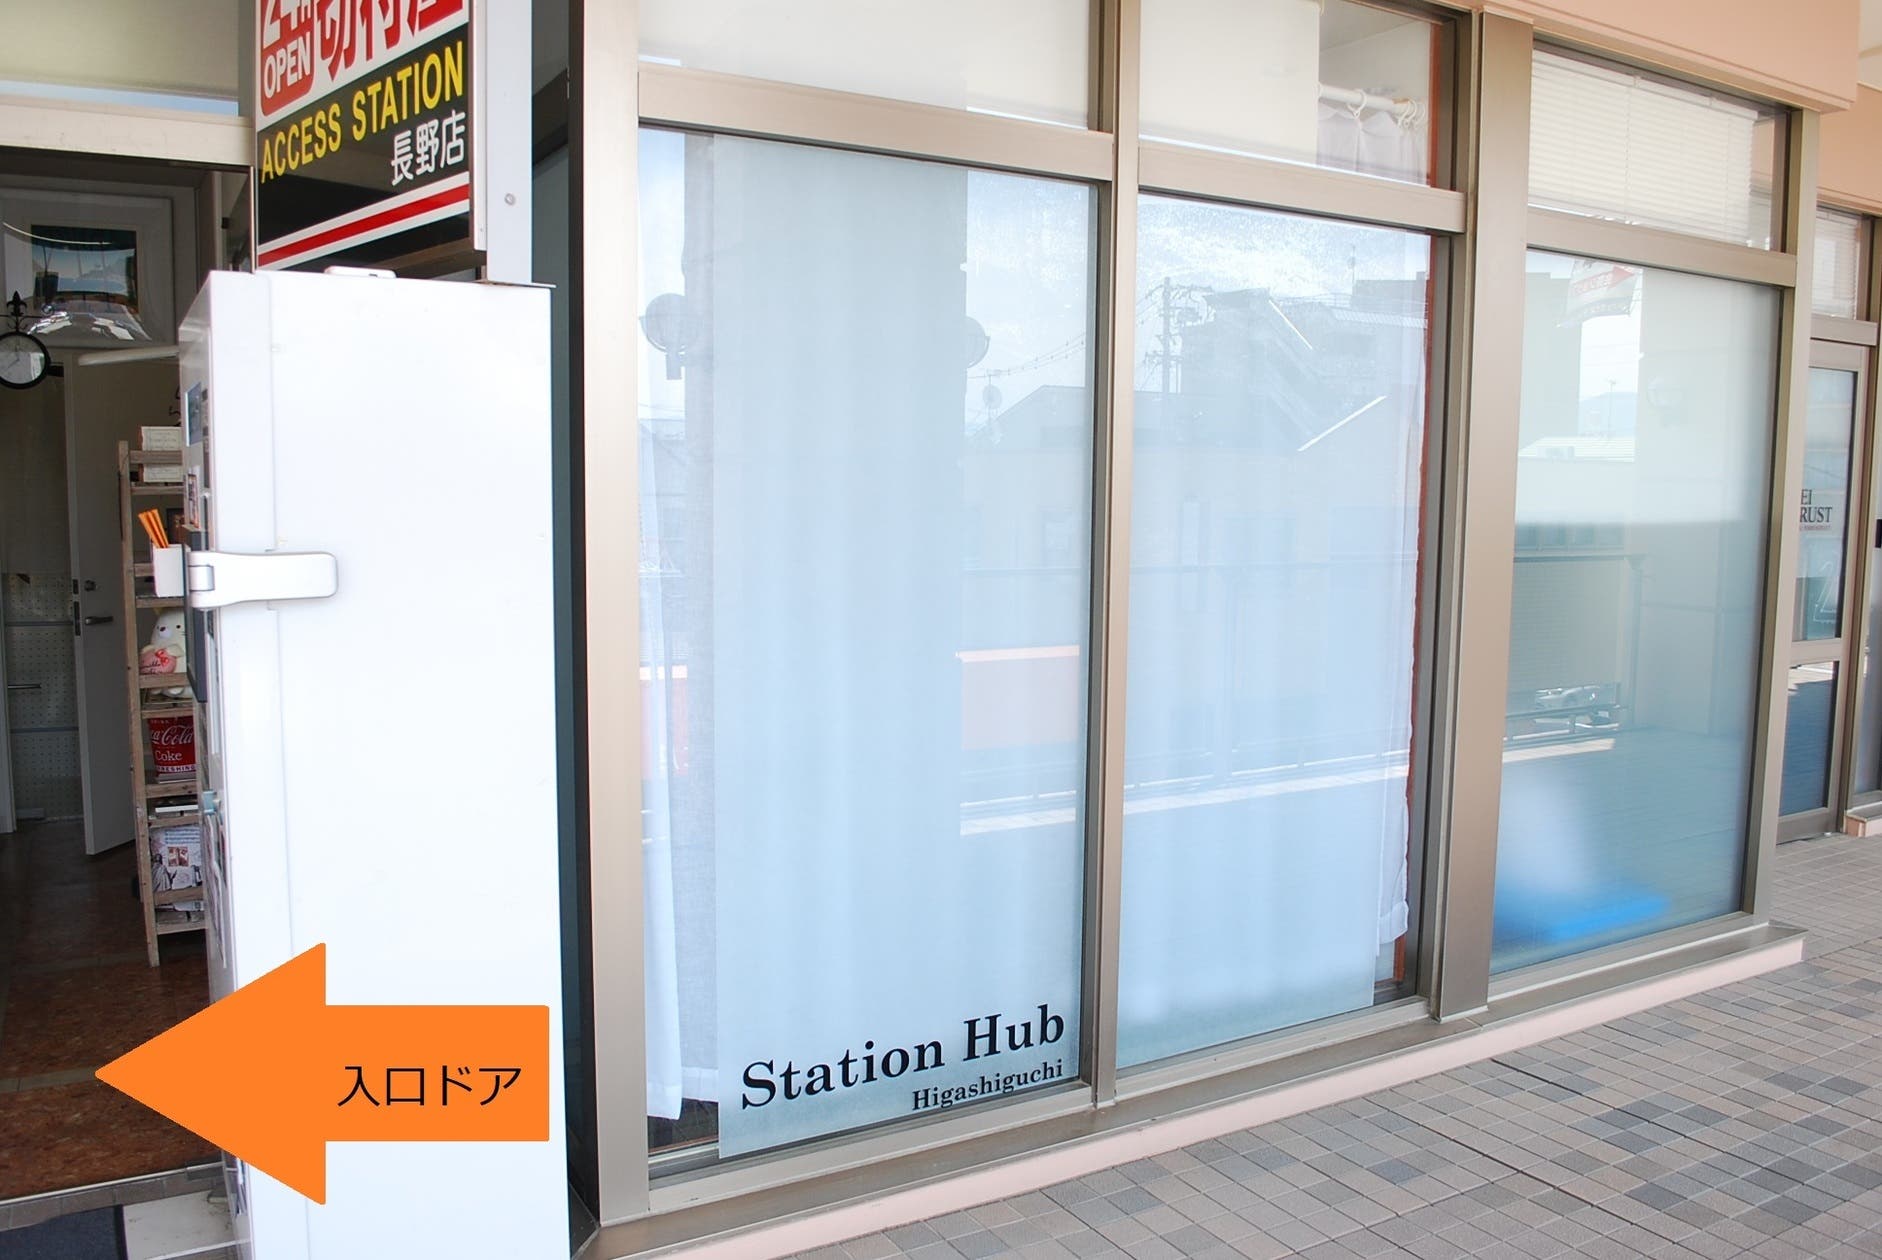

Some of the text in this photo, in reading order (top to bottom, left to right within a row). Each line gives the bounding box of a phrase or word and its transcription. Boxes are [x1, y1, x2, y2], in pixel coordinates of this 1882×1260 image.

[263, 31, 311, 99] OPEN
[261, 41, 464, 184] ACCESS STATION
[391, 109, 466, 187] 長野店
[155, 750, 183, 761] Coke
[742, 1003, 1065, 1110] Station Hub
[912, 1058, 1064, 1111] Higashiguchi
